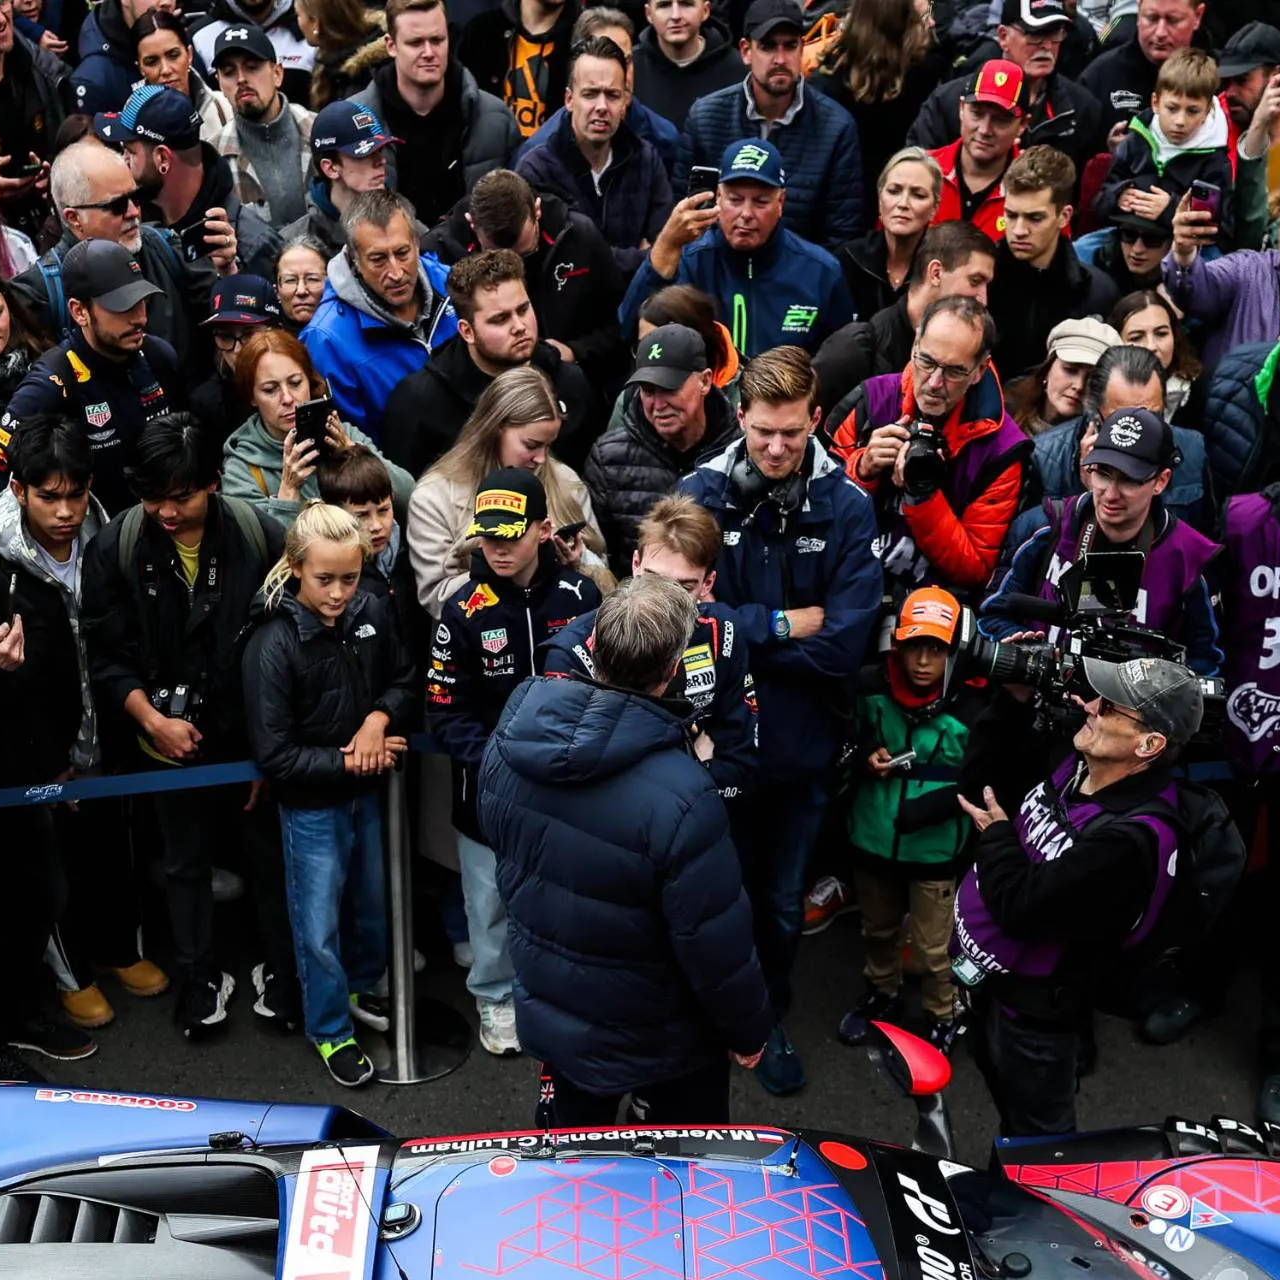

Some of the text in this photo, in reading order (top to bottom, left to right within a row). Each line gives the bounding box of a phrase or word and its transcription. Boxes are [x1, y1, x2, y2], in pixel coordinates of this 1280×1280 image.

[1077, 524, 1095, 562] DIGITA
[208, 567, 217, 586] EOS
[483, 629, 505, 641] TAG
[722, 620, 734, 658] sparco
[572, 644, 596, 680] spar
[36, 1090, 197, 1113] GOODRIDGE
[410, 1136, 539, 1156] C.Lulham
[306, 1171, 340, 1260] auto
